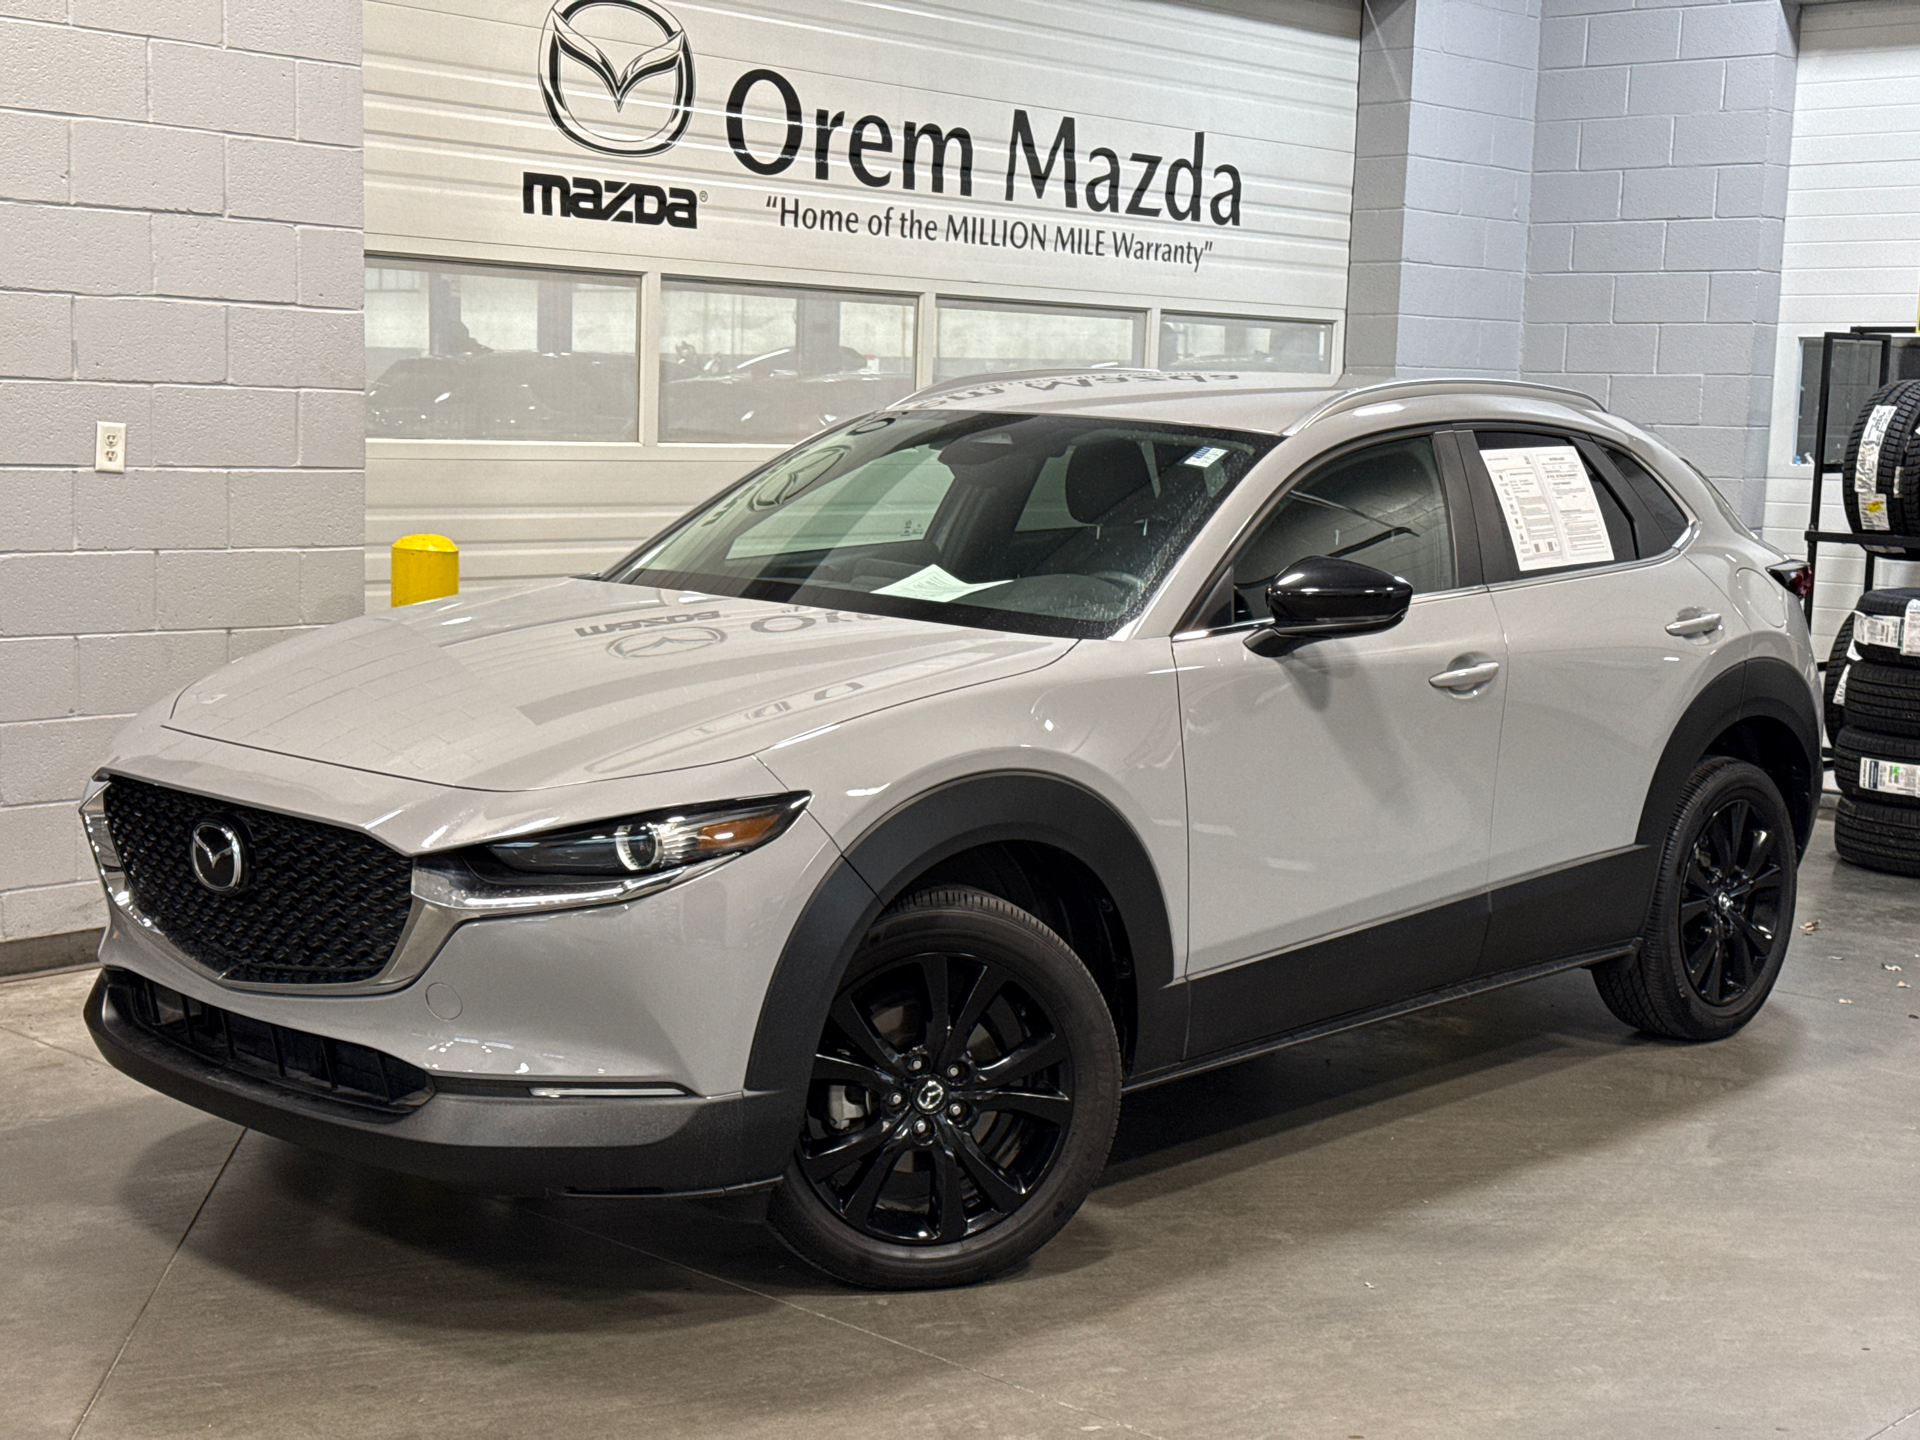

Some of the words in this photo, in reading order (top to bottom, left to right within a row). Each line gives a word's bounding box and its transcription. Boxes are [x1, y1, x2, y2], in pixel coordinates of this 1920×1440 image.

[725, 68, 974, 197] Orem
[1004, 108, 1242, 227] Mazda
[765, 195, 860, 234] “Home
[866, 205, 895, 237] of
[899, 208, 938, 240] the
[945, 214, 1048, 251] MILLION
[1053, 225, 1106, 257] MILE
